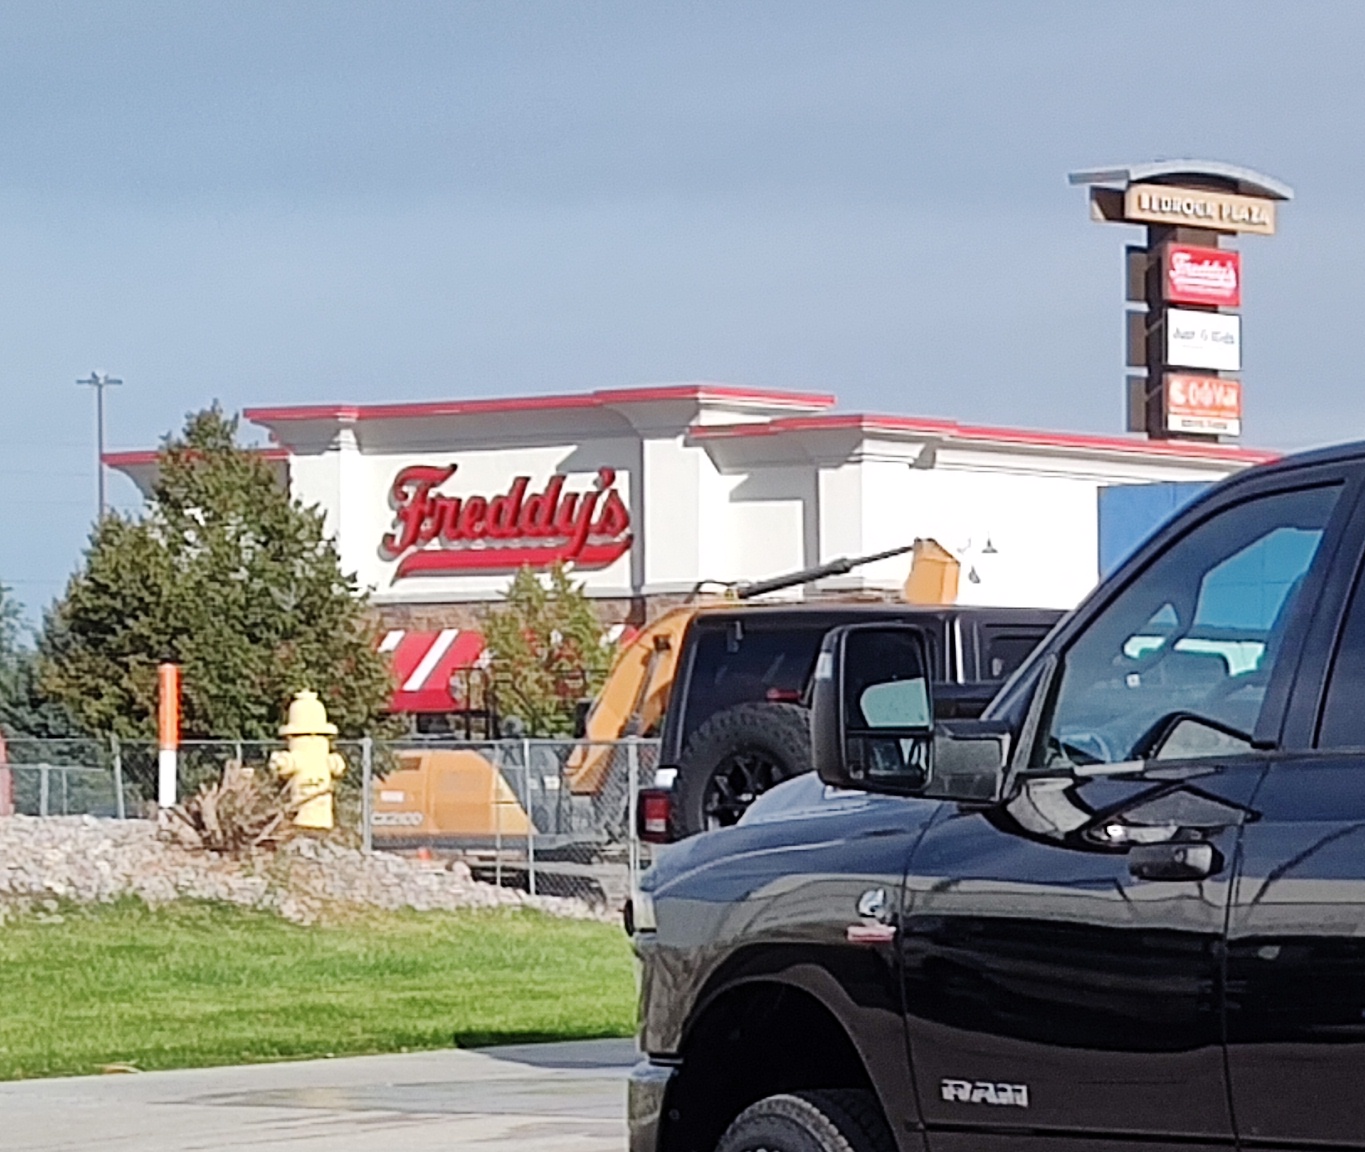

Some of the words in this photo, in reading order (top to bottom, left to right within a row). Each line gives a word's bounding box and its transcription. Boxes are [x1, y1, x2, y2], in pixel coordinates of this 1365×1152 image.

[1218, 203, 1269, 225] PLAZA
[383, 463, 631, 558] Freddy's
[941, 1079, 1029, 1107] RAM
